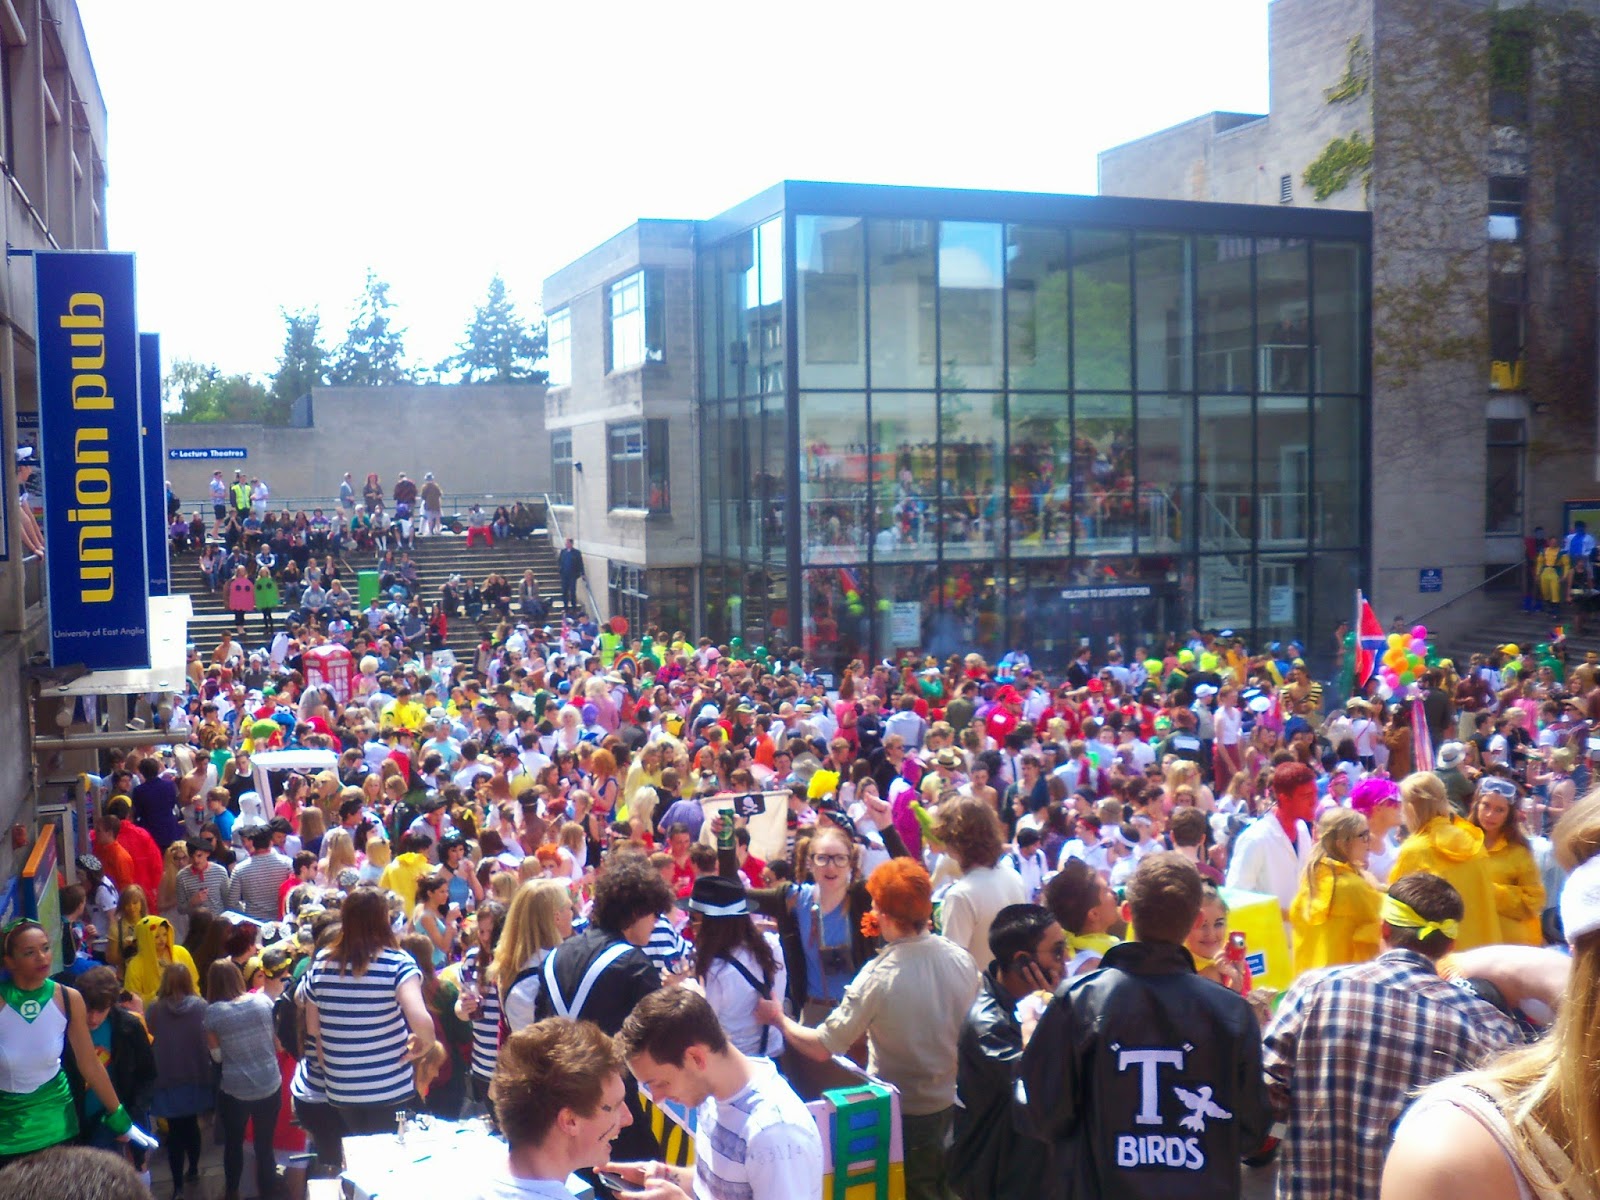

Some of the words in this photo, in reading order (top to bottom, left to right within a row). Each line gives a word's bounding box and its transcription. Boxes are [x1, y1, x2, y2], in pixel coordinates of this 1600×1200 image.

[60, 292, 114, 410] pub
[179, 450, 208, 458] Lecture
[210, 449, 244, 457] Theatres
[68, 427, 114, 603] union
[53, 629, 91, 639] University
[92, 628, 101, 637] of
[102, 627, 119, 636] East
[120, 626, 145, 637] Anglia
[1118, 1135, 1205, 1170] BIRDS
